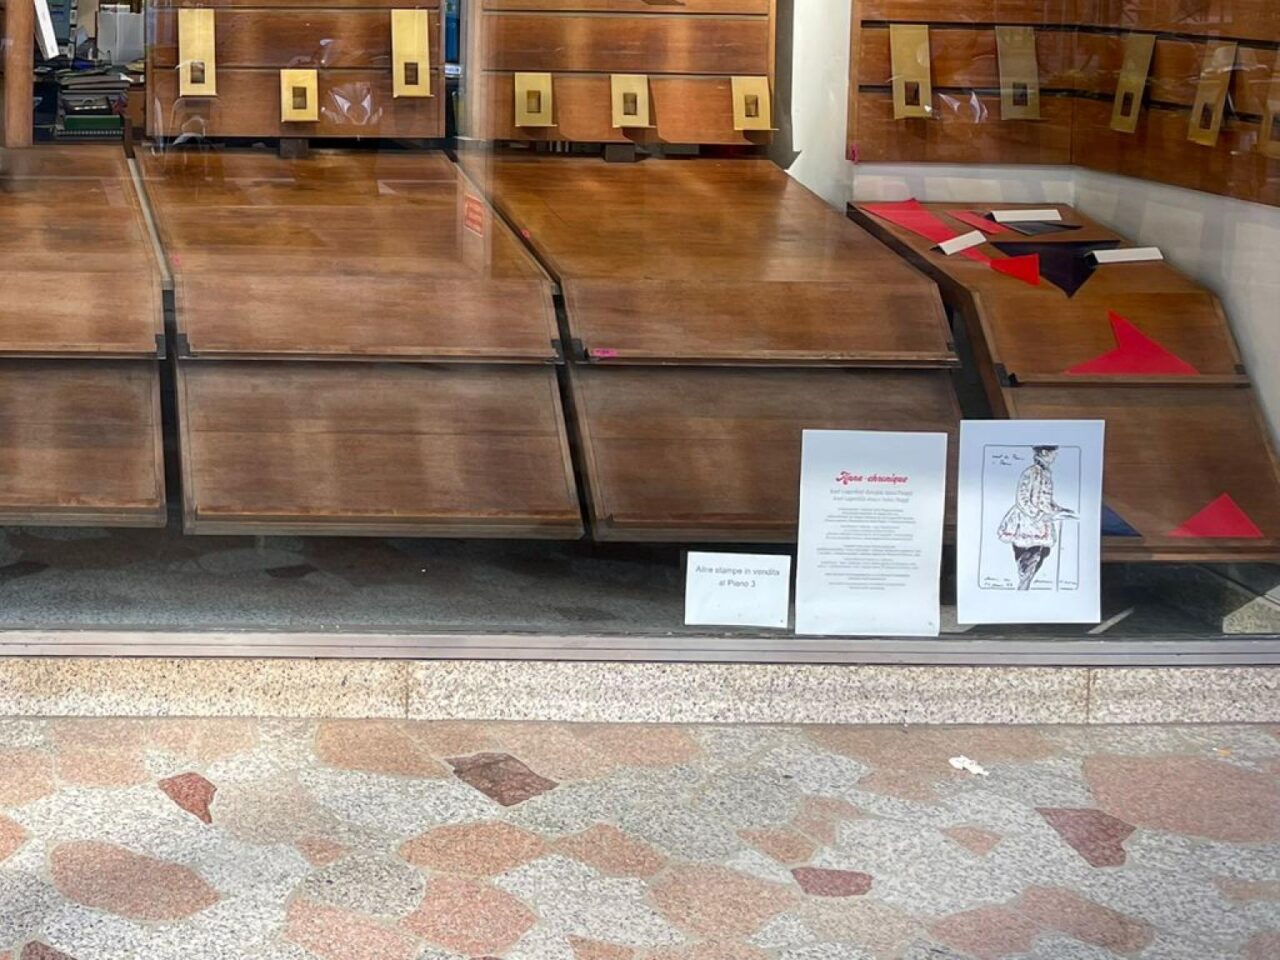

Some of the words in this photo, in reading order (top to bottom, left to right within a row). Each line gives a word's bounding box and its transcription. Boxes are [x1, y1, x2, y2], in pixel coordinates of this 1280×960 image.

[715, 566, 743, 576] stampe
[745, 567, 752, 575] in
[753, 567, 781, 577] vendita
[727, 579, 750, 588] Piano
